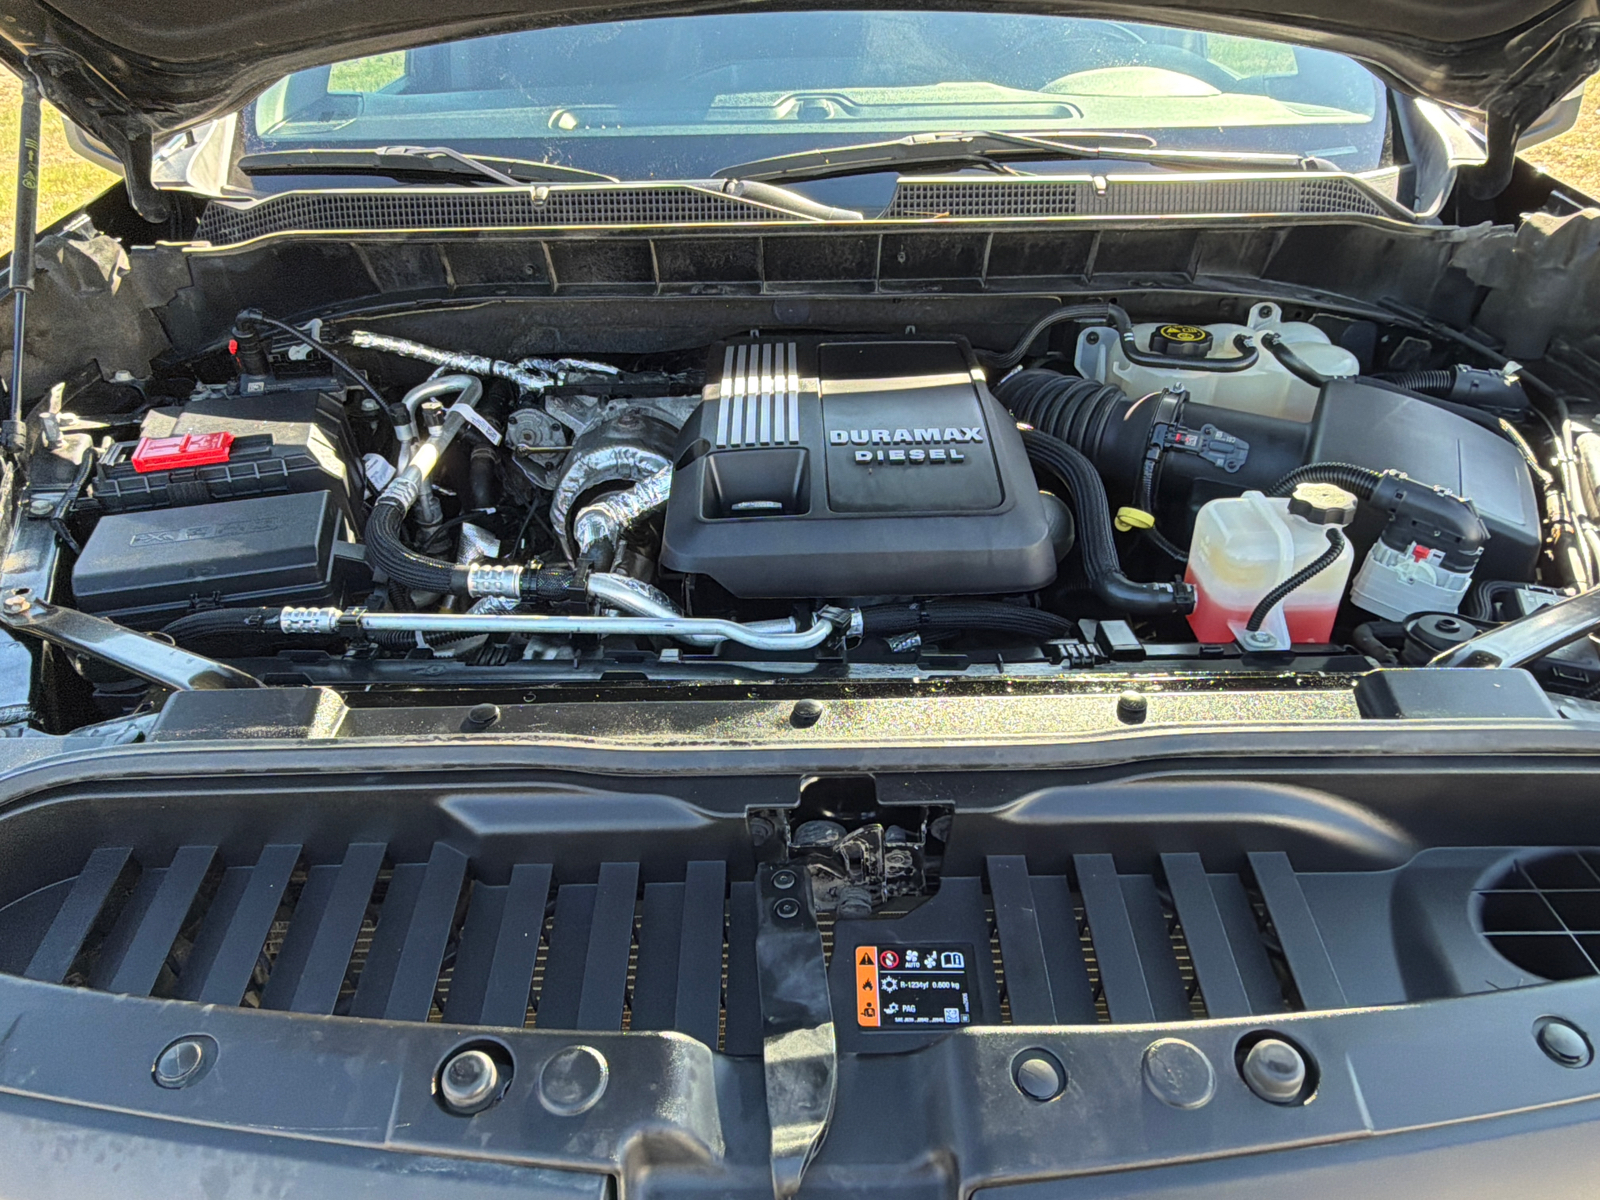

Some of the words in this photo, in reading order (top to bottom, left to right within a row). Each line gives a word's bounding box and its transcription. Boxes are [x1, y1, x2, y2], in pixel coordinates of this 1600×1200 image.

[829, 427, 984, 445] DURAMAX
[855, 449, 964, 464] DIESEL
[900, 981, 929, 990] R-1234yf
[951, 981, 960, 990] kg
[902, 1005, 916, 1013] PAG
